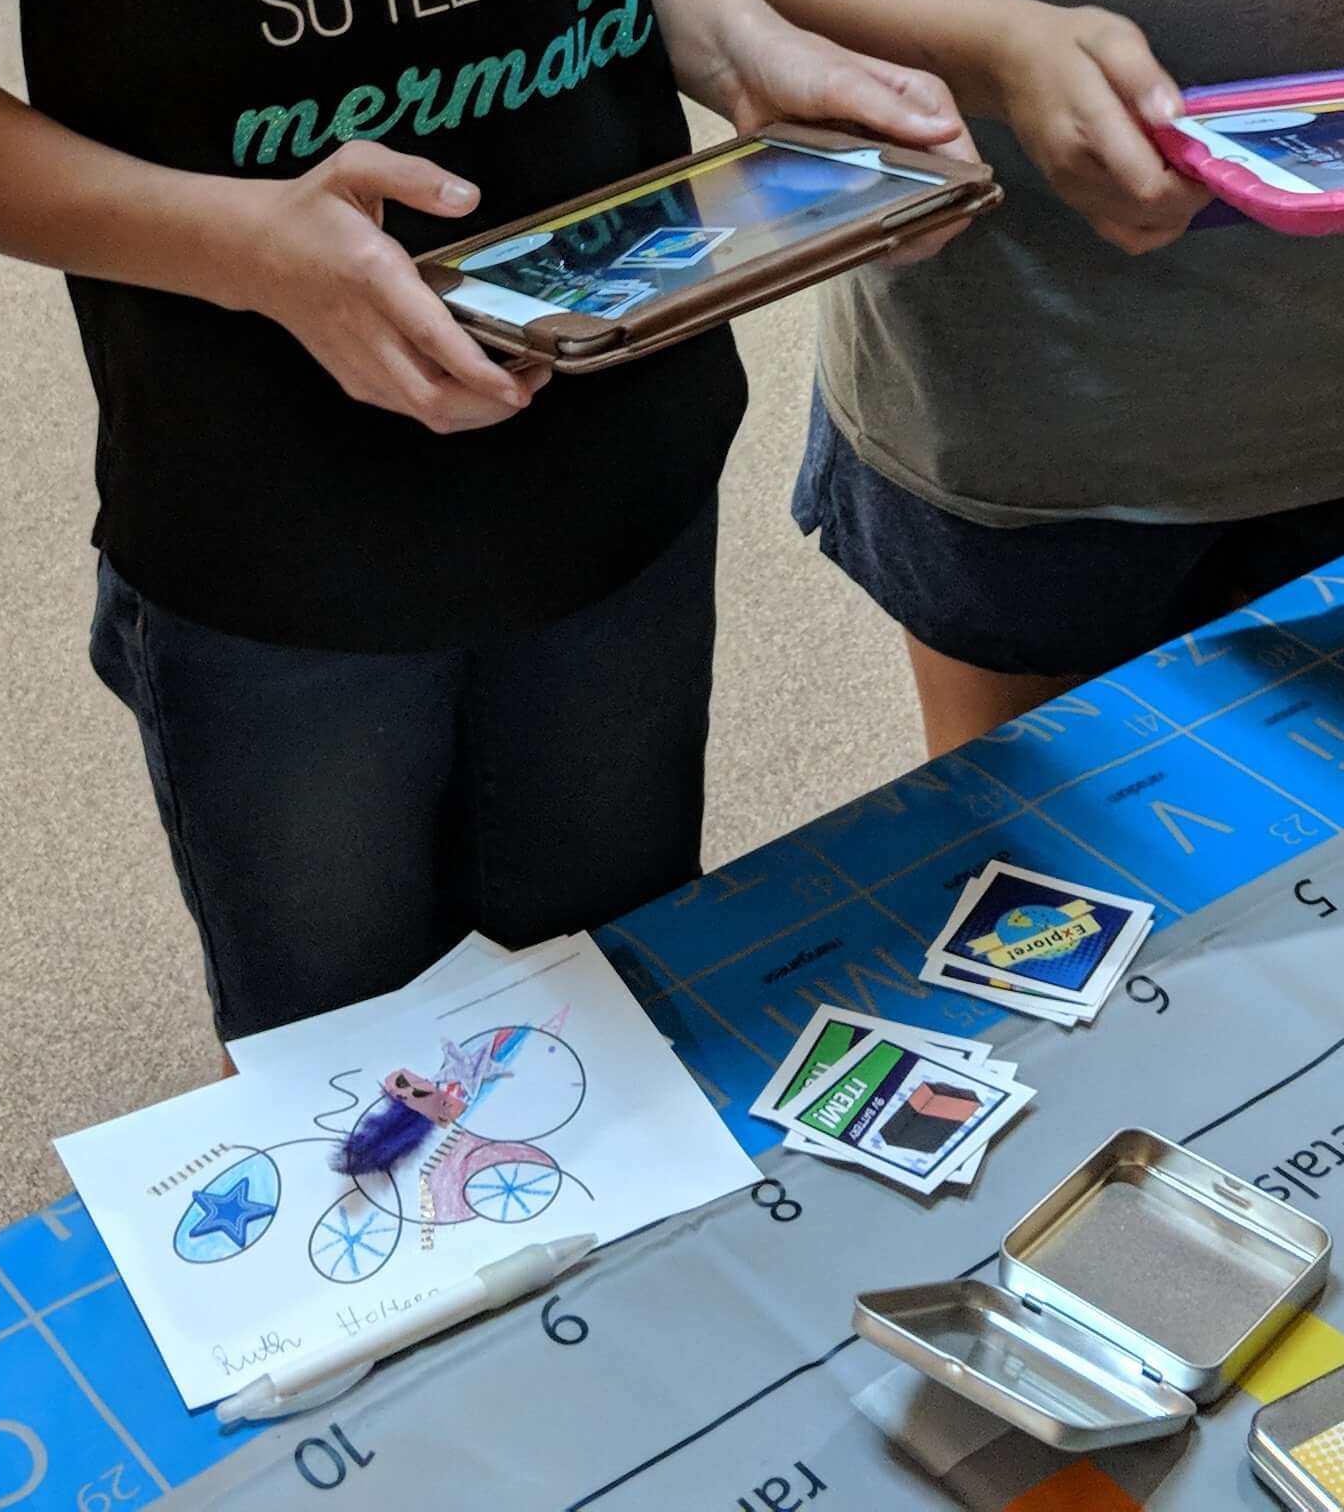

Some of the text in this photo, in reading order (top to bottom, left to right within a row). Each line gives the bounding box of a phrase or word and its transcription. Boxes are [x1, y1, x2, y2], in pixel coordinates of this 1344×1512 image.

[1149, 798, 1235, 854] V
[1268, 813, 1319, 846] 23
[1294, 879, 1338, 918] 5
[1006, 920, 1089, 962] Explore!
[1125, 972, 1170, 1016] 6
[815, 1075, 868, 1131] ITEM!
[848, 1108, 878, 1140] BATTERY
[751, 1178, 802, 1224] 8
[541, 1295, 589, 1346] 9
[293, 1422, 376, 1491] 10
[76, 1463, 142, 1512] 29
